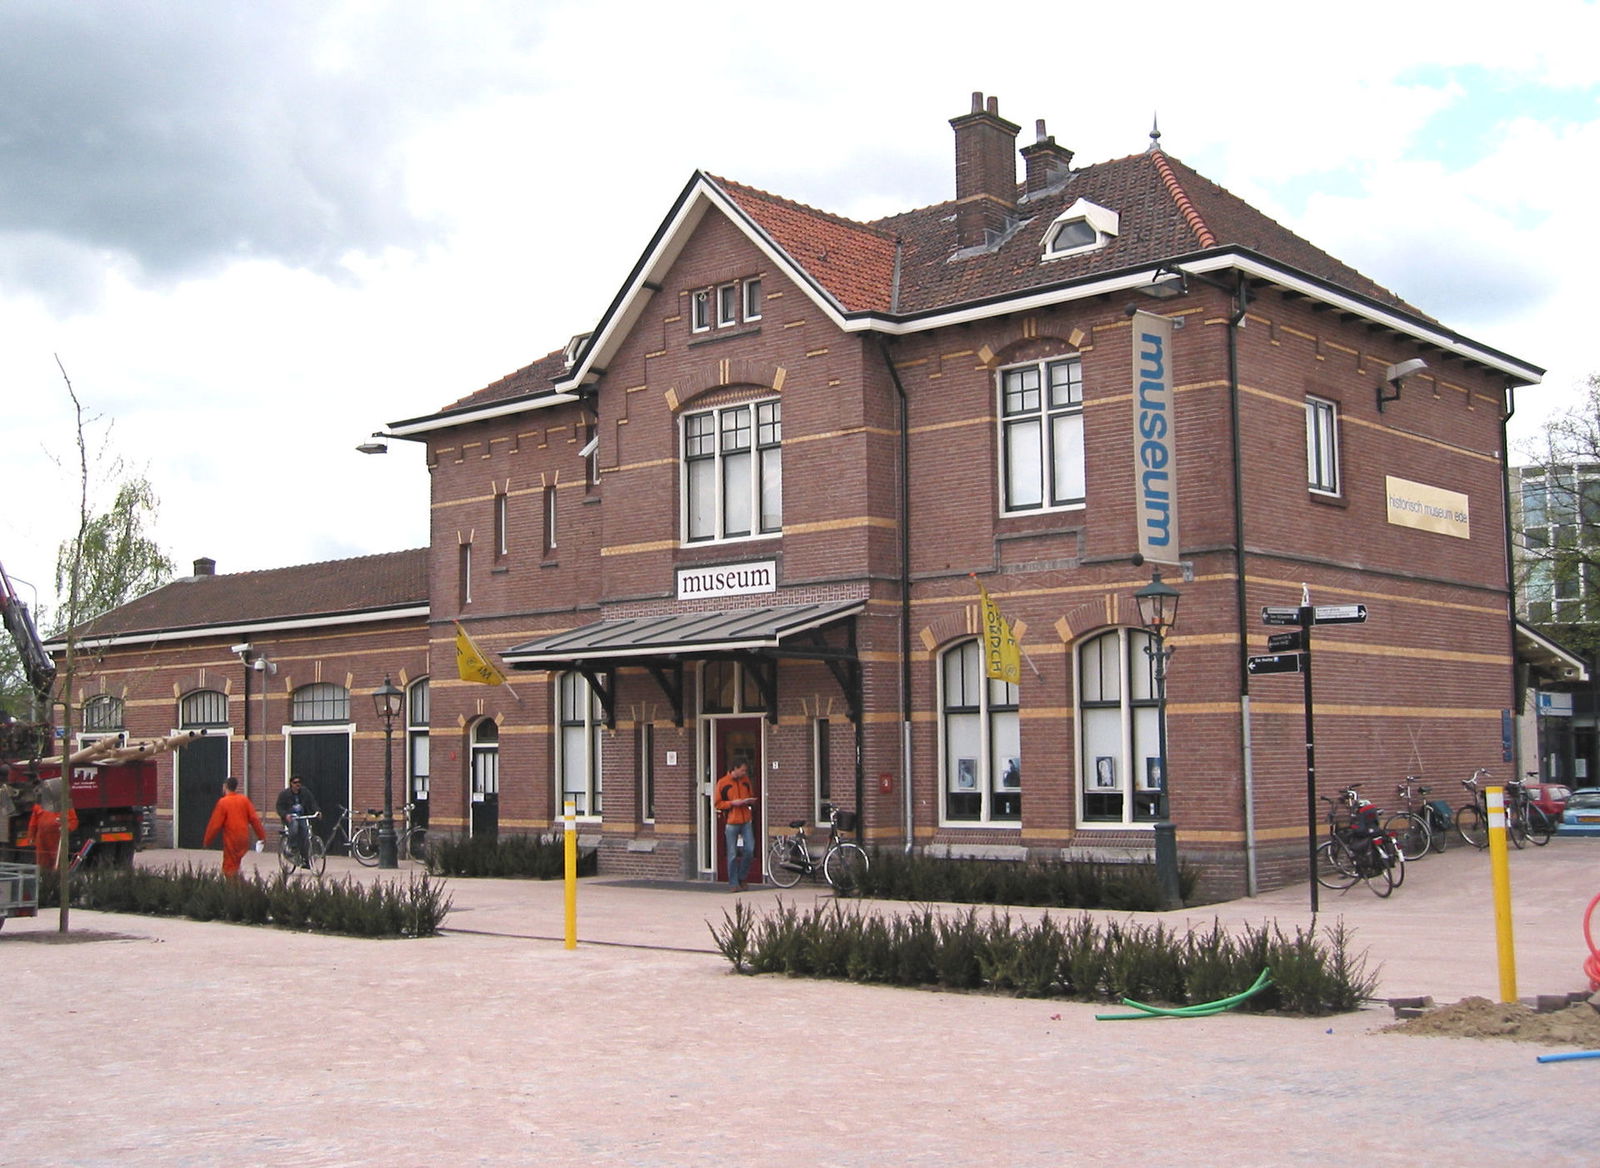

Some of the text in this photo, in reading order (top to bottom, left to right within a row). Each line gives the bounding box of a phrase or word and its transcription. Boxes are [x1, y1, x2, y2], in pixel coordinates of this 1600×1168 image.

[1139, 332, 1171, 547] museum
[1389, 495, 1468, 523] historisch museum ede
[682, 567, 771, 594] museum
